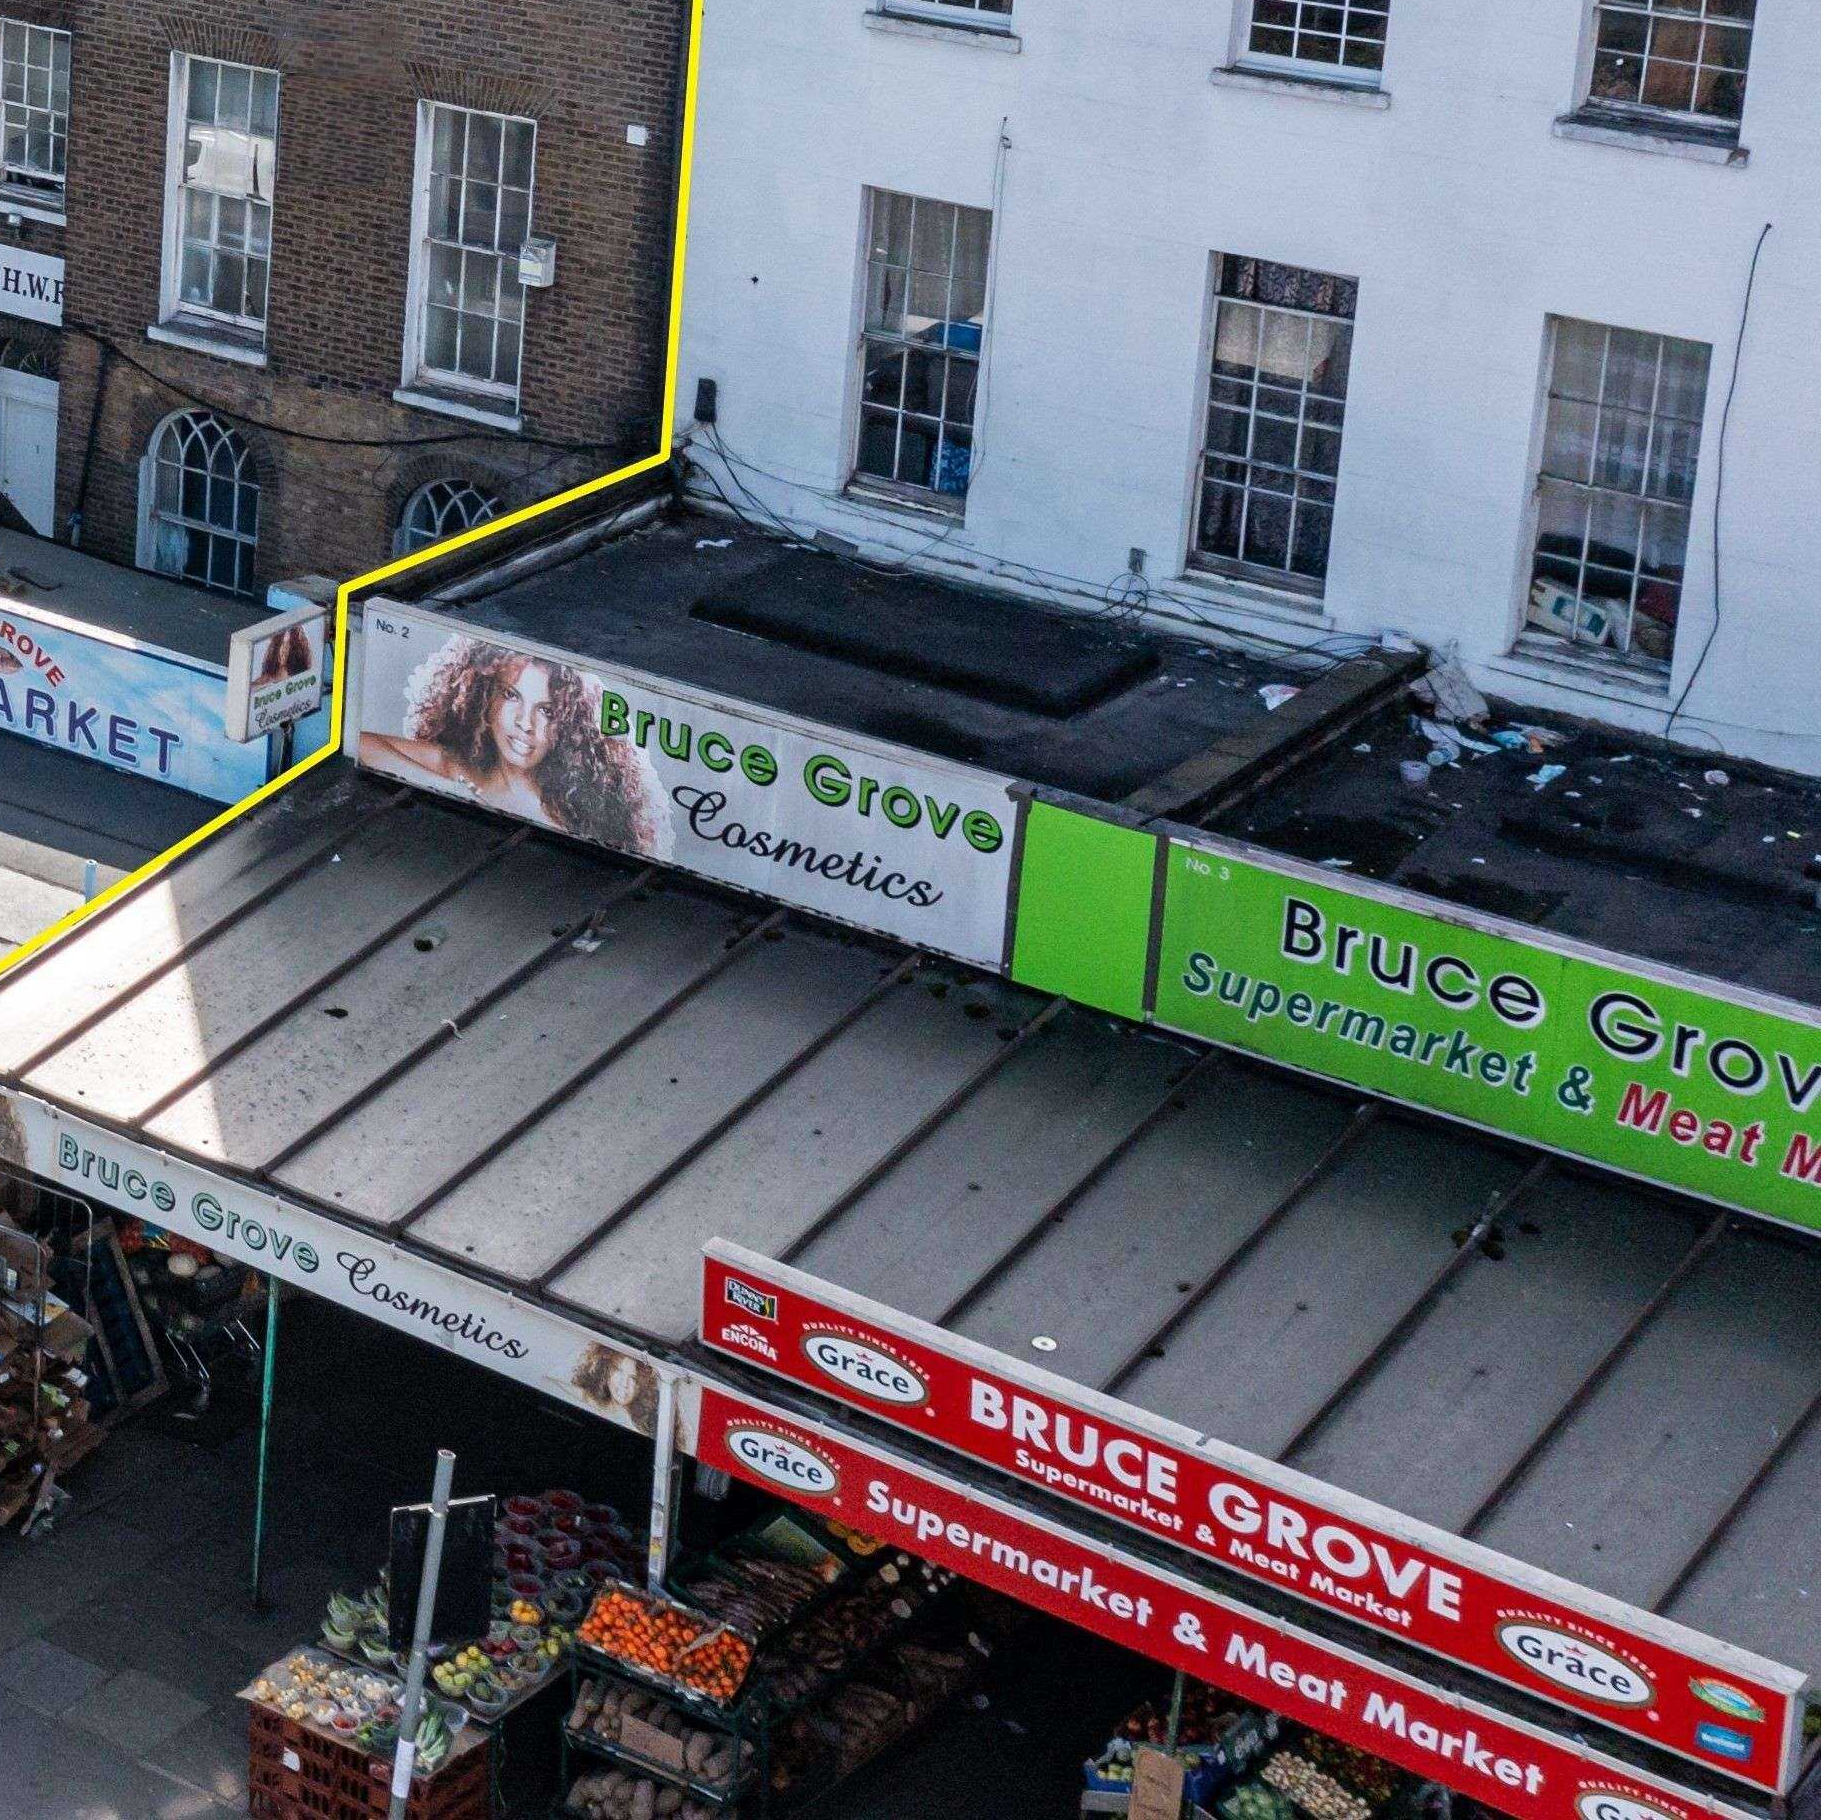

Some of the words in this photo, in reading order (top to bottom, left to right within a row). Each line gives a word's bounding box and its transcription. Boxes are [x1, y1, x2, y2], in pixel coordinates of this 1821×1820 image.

[285, 675, 317, 696] Grove
[600, 688, 779, 788] Bruce
[803, 751, 1005, 855] Grove
[671, 784, 945, 908] Cosmetics
[1218, 866, 1231, 881] 3
[1279, 894, 1546, 1031] Bruce
[1182, 951, 1537, 1097] Supermarket
[1557, 1063, 1596, 1116] &
[1615, 1082, 1767, 1169] Meat
[57, 1131, 177, 1212] Bruce
[190, 1191, 319, 1274] Grove
[336, 1250, 530, 1360] Cosmetics
[721, 1327, 778, 1362] ENCONA
[801, 1321, 854, 1336] QUALITY
[817, 1343, 910, 1395] Grace
[740, 1437, 823, 1484] Grace
[970, 1377, 1179, 1504] BRUCE
[1208, 1481, 1465, 1622] GROVE
[1014, 1448, 1184, 1532] Supermarket
[1194, 1523, 1217, 1547] &
[1228, 1536, 1302, 1582] Meat
[1309, 1569, 1413, 1630] Market
[865, 1480, 1154, 1630] Supermarket
[1172, 1611, 1210, 1654] &
[1224, 1632, 1350, 1711] Meat
[1363, 1692, 1546, 1797] Market
[1495, 1608, 1562, 1627] QUALITY
[1516, 1634, 1632, 1696] Grace
